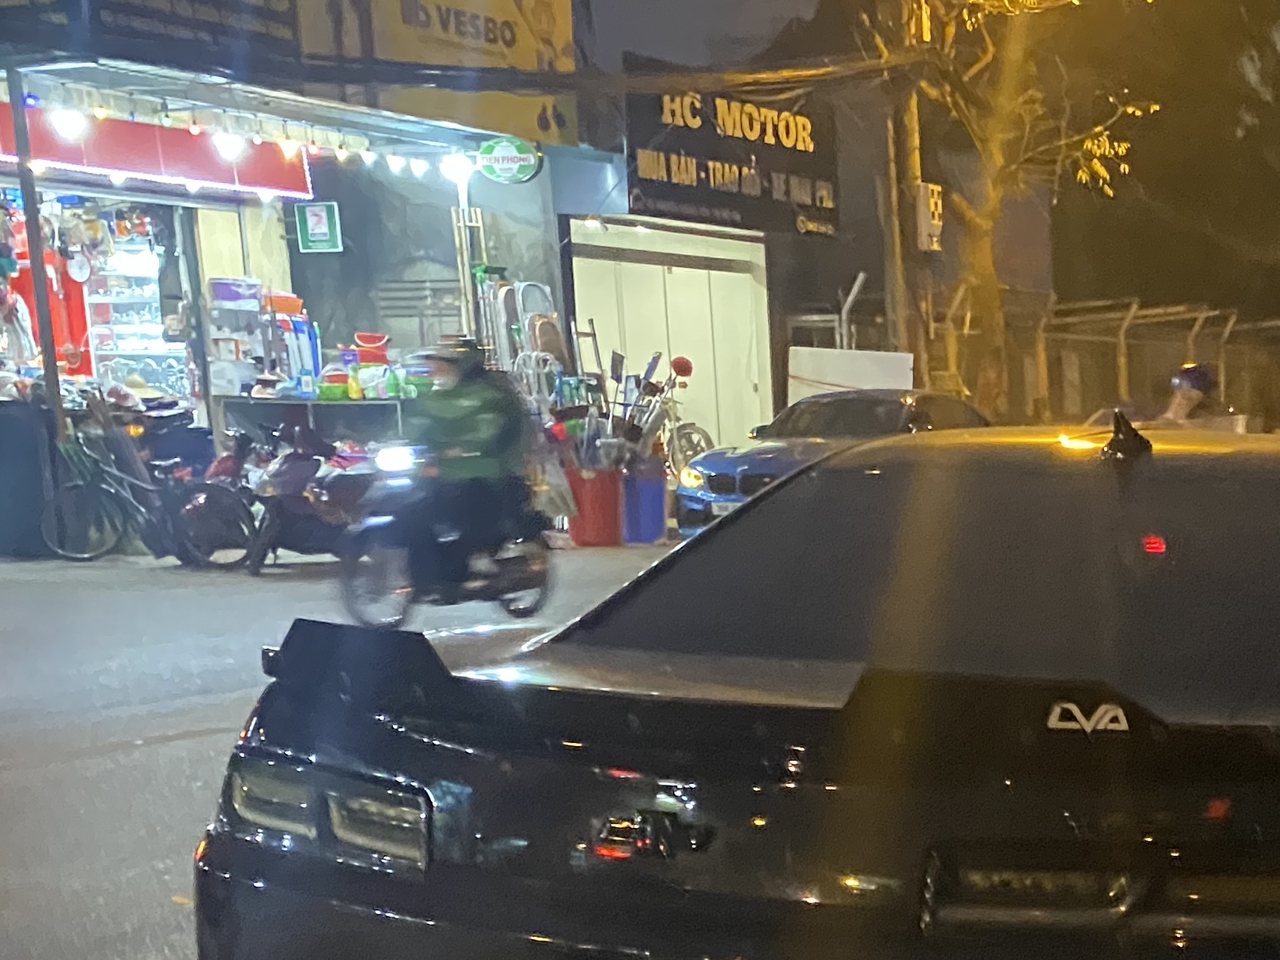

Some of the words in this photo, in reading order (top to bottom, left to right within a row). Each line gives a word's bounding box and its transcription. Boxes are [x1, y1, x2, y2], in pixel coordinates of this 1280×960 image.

[436, 4, 517, 48] VESBO
[715, 98, 815, 152] MOTOR
[502, 156, 532, 164] PHONG
